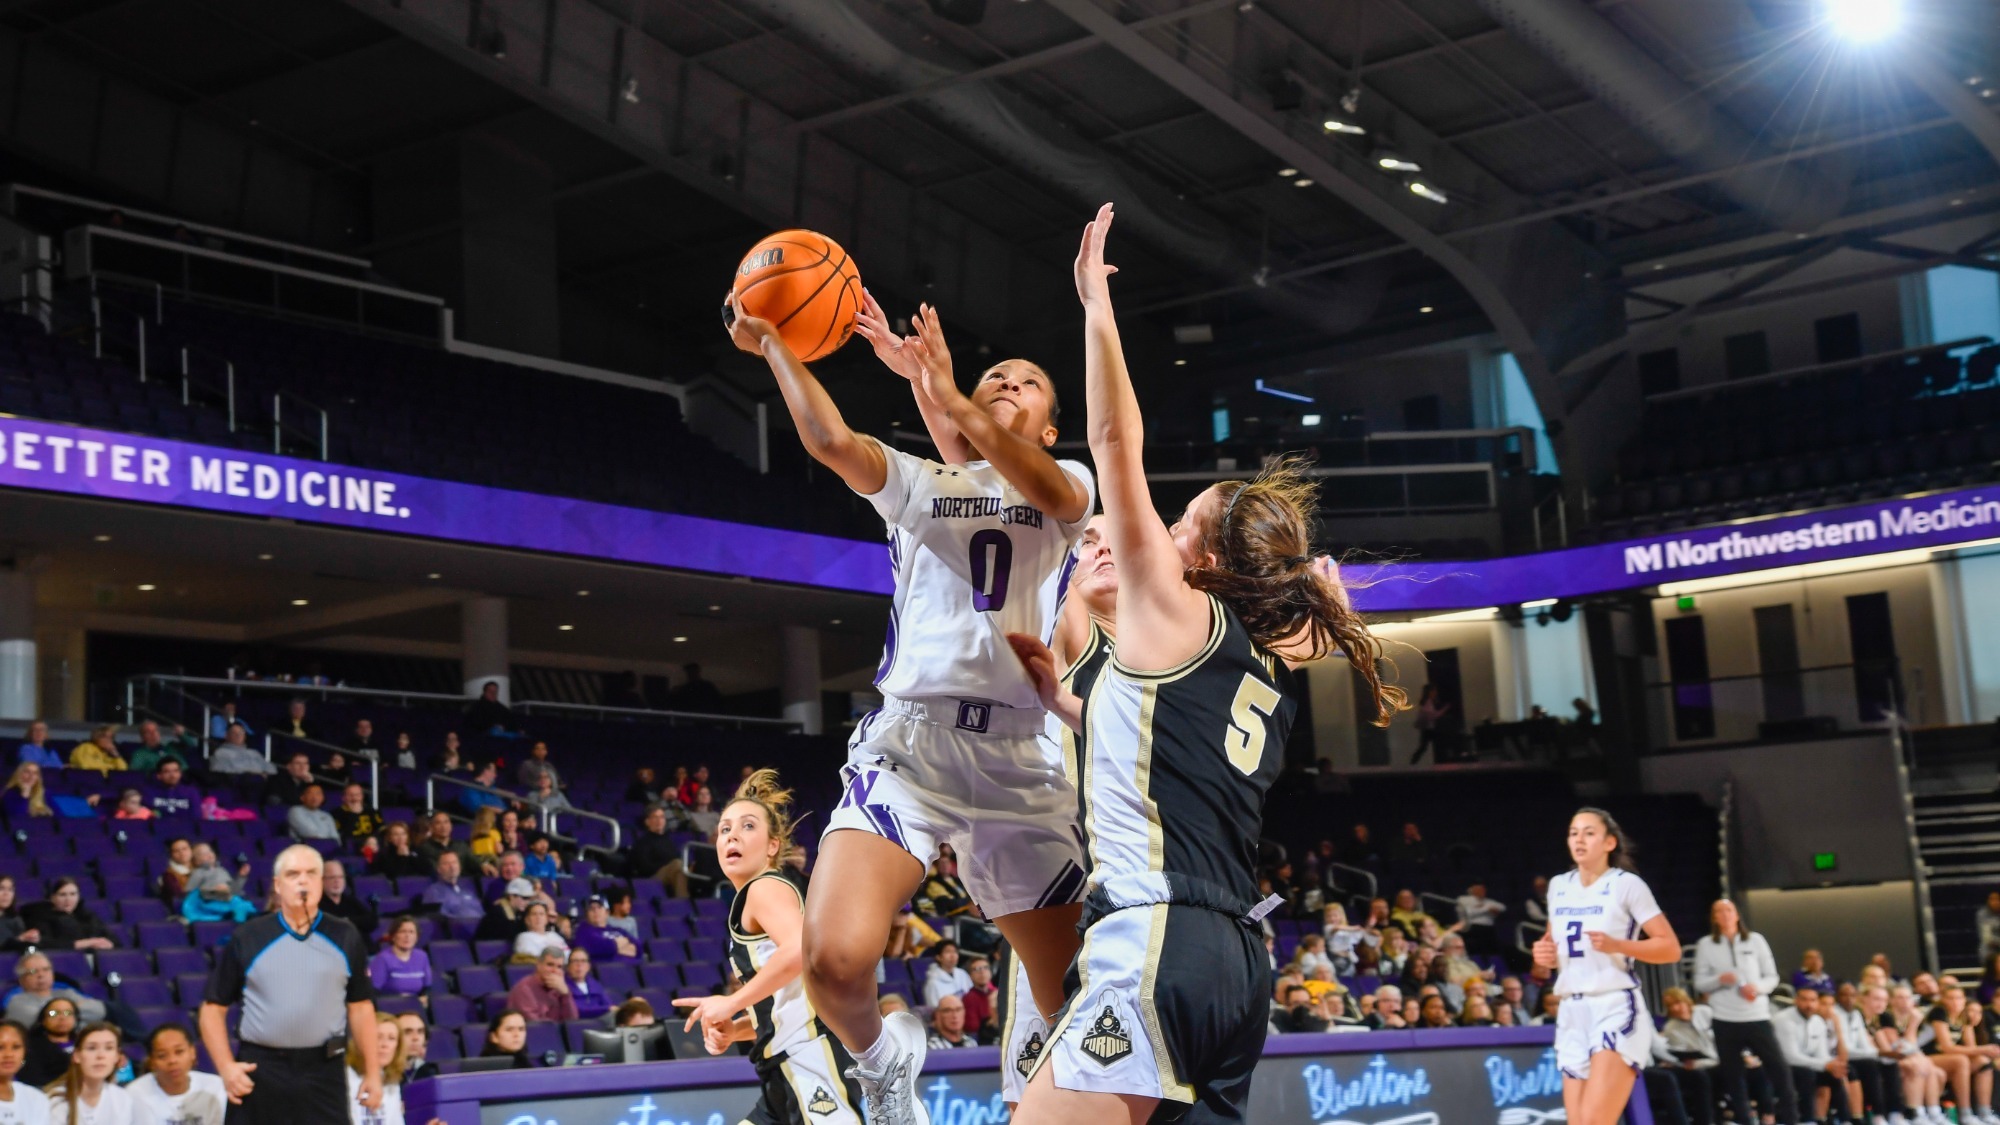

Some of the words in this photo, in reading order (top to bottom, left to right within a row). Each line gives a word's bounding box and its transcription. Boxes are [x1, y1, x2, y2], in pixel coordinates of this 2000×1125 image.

[191, 456, 411, 518] MEDICINE.
[931, 496, 1043, 530] NORTHWSTERN
[1666, 518, 1876, 568] Northwestern
[968, 528, 1013, 613] 0
[965, 706, 982, 727] N
[1224, 672, 1282, 777] 5
[841, 770, 880, 810] N
[1566, 921, 1585, 958] 2
[1018, 1058, 1036, 1074] PUR
[1084, 1035, 1130, 1059] PURDUE
[1301, 1053, 1432, 1120] Bluestone
